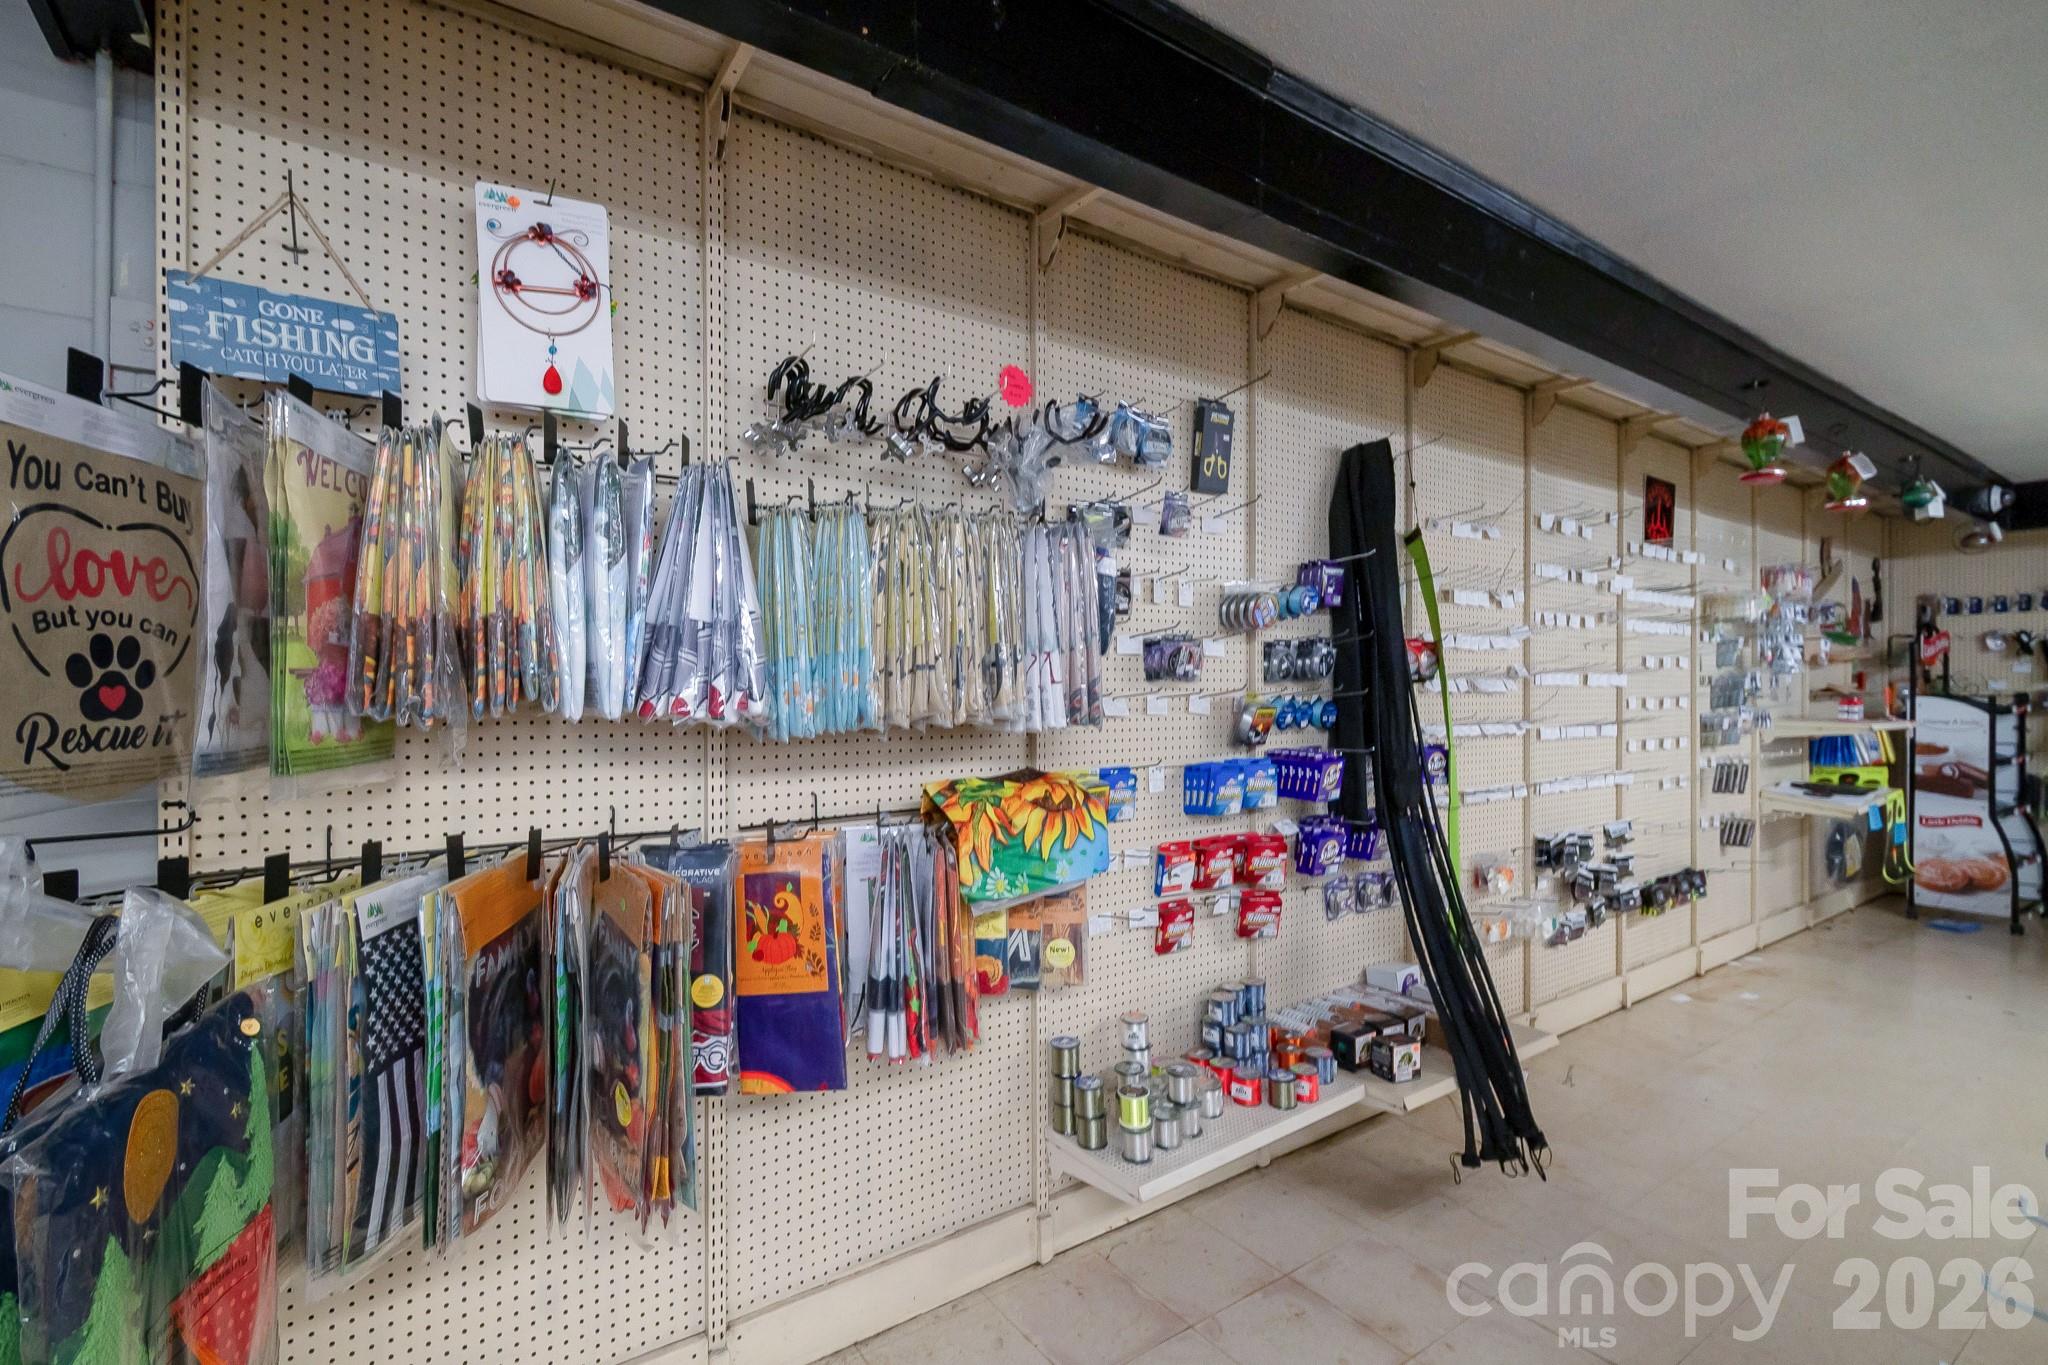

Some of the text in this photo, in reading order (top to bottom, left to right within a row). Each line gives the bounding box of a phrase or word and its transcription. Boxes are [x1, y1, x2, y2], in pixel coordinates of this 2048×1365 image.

[205, 310, 378, 364] FISHING
[259, 300, 325, 326] GONE
[220, 348, 368, 380] CATCH YOU LATER
[7, 439, 194, 536] You Can't Buy
[296, 448, 368, 504] WELCO
[14, 526, 193, 610] love
[32, 605, 178, 646] But you can
[15, 710, 188, 771] Rescue it
[672, 868, 720, 877] CORATIVE
